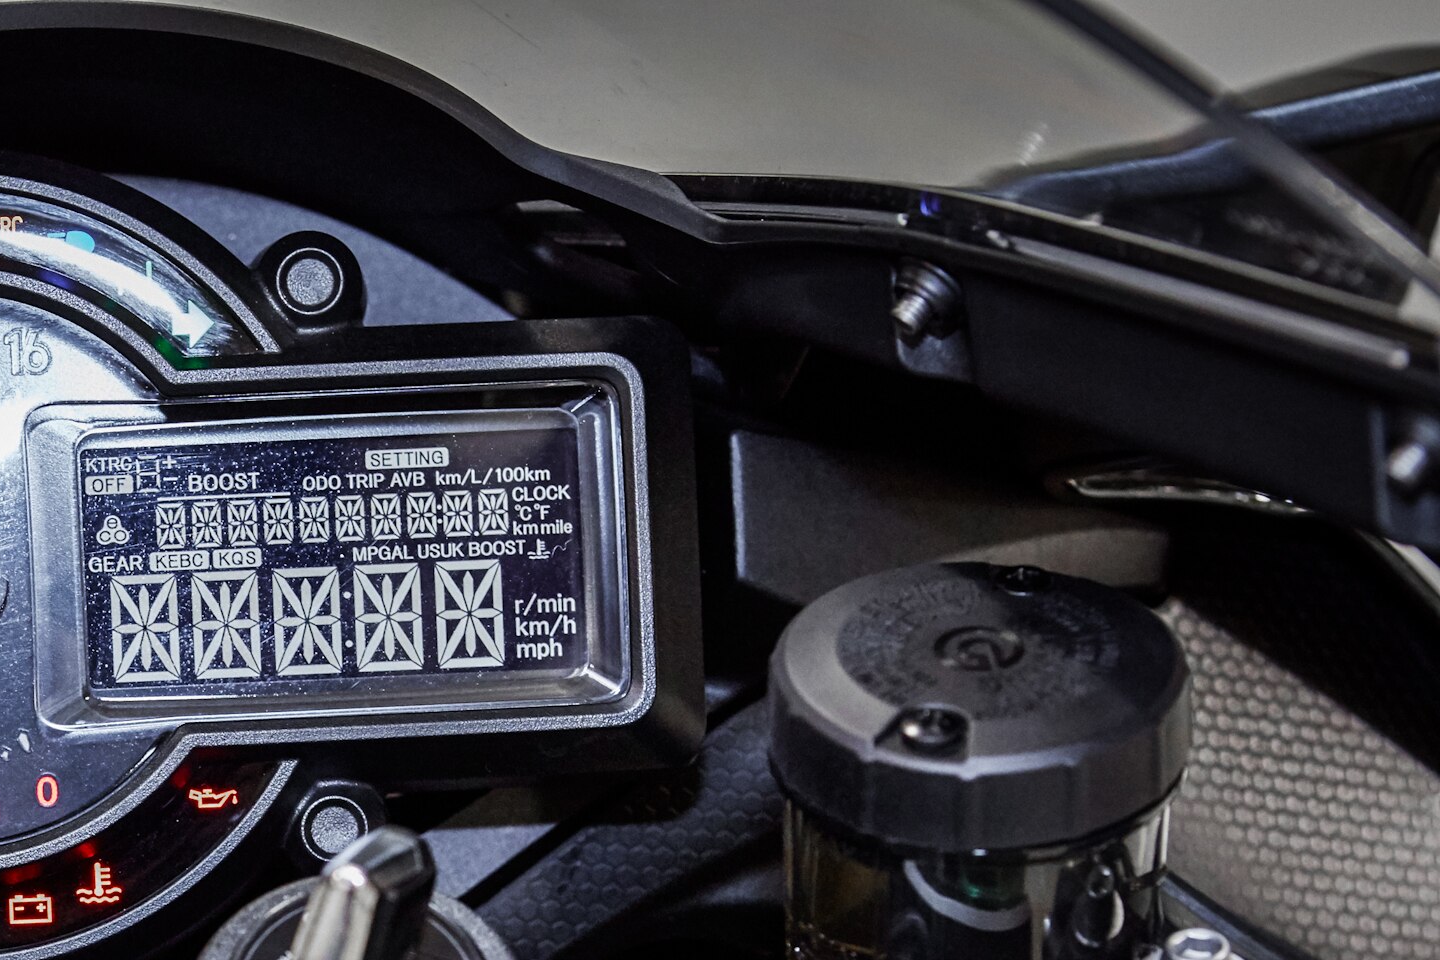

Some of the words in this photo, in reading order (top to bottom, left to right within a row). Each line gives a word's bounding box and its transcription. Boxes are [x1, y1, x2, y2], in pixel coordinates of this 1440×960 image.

[3, 327, 52, 376] 16
[85, 456, 133, 473] KTRC
[370, 450, 444, 468] SETTING
[92, 478, 126, 493] OFF
[188, 472, 260, 493] BOOST
[302, 475, 342, 491] ODO
[345, 473, 385, 489] TRIP
[390, 471, 426, 488] AVB
[511, 484, 572, 502] CLOCK
[219, 550, 257, 566] KQS
[468, 539, 527, 558] BOOST
[88, 556, 143, 573] GEAR
[155, 553, 204, 569] KEBC
[514, 592, 576, 616] r/min
[515, 614, 577, 637] km/h
[516, 637, 563, 660] mph
[35, 774, 59, 808] 0
